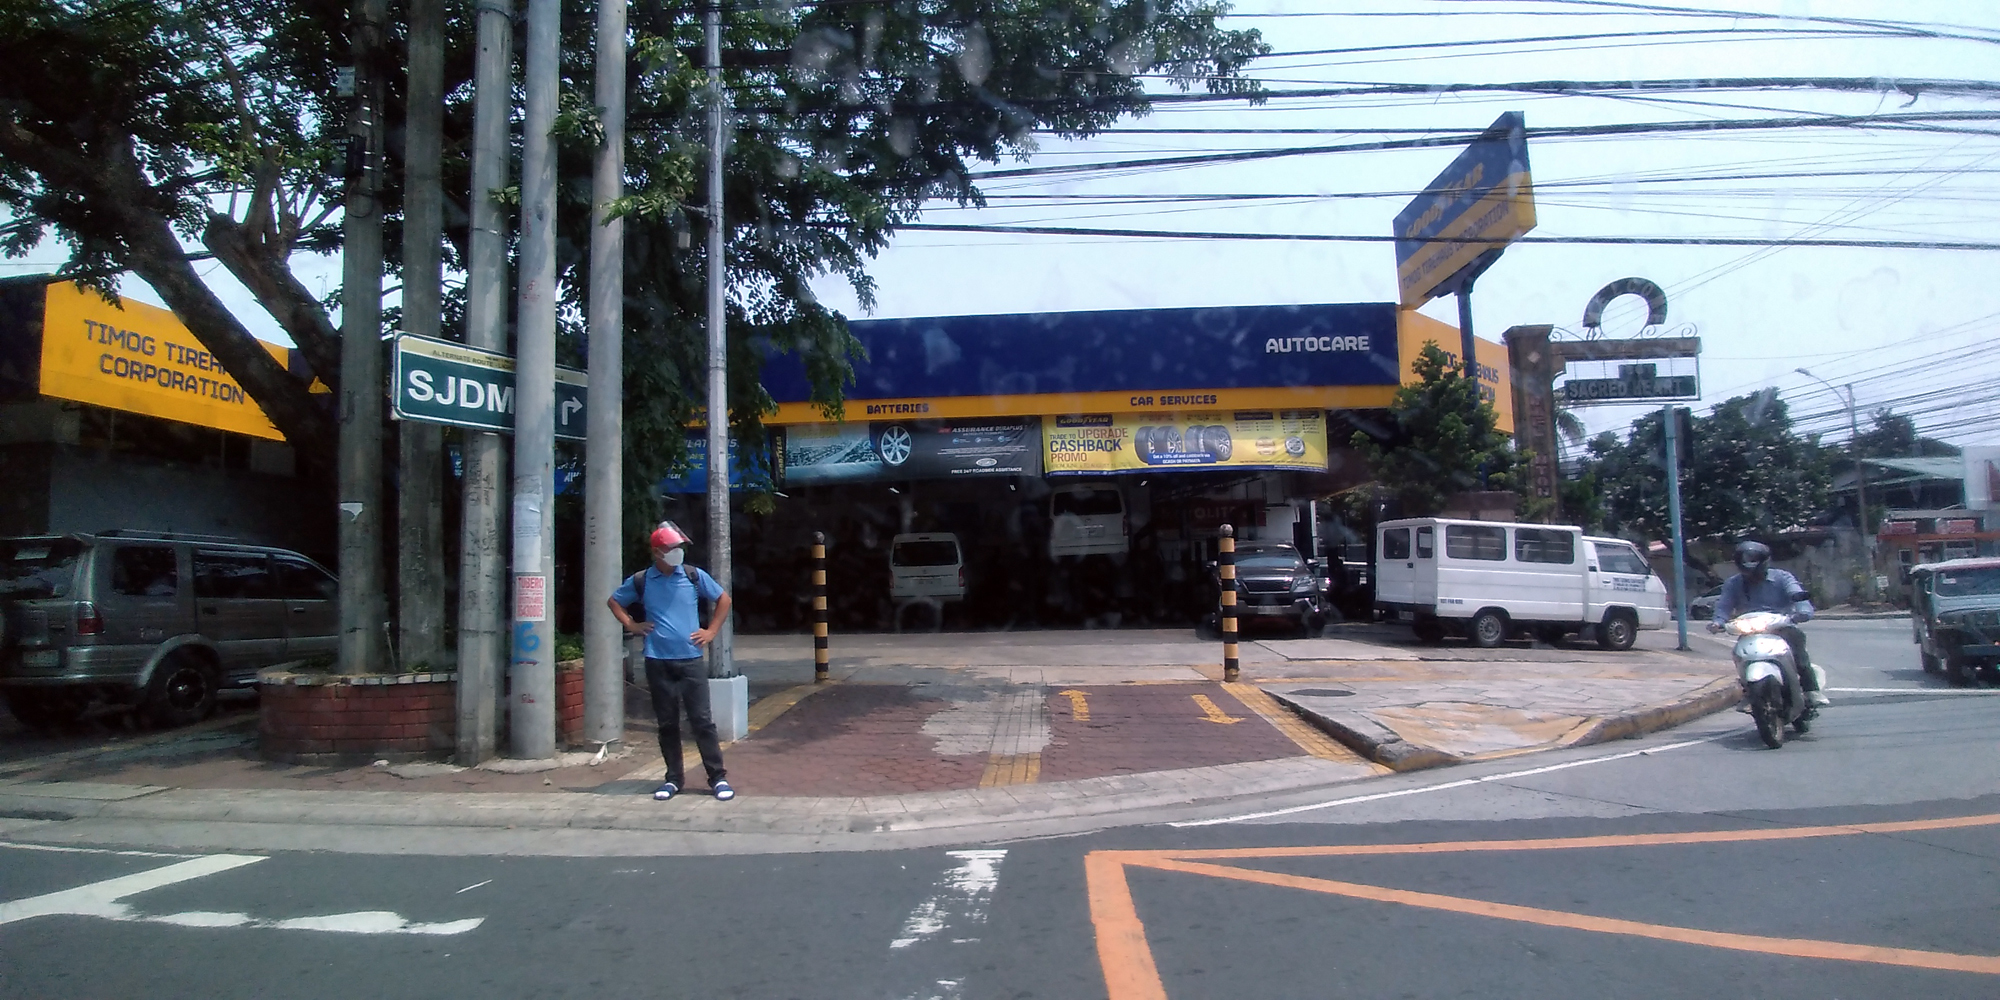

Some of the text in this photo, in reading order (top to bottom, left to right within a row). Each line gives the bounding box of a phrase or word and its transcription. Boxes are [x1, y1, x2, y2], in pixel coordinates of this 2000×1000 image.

[84, 319, 226, 376] TIMOG TIREH
[1265, 335, 1370, 353] AUTOCARE
[432, 350, 471, 362] ALTERNATE
[473, 357, 494, 367] ROUTE
[100, 353, 245, 405] CORPORATION
[408, 370, 514, 414] SJDM
[1568, 380, 1627, 398] SACRED
[1130, 394, 1218, 406] CAR SERVICES
[866, 403, 929, 415] BATTERIES
[1078, 428, 1129, 439] UPGRADE
[1050, 439, 1123, 452] CASHBACK
[1050, 452, 1088, 463] PROMO
